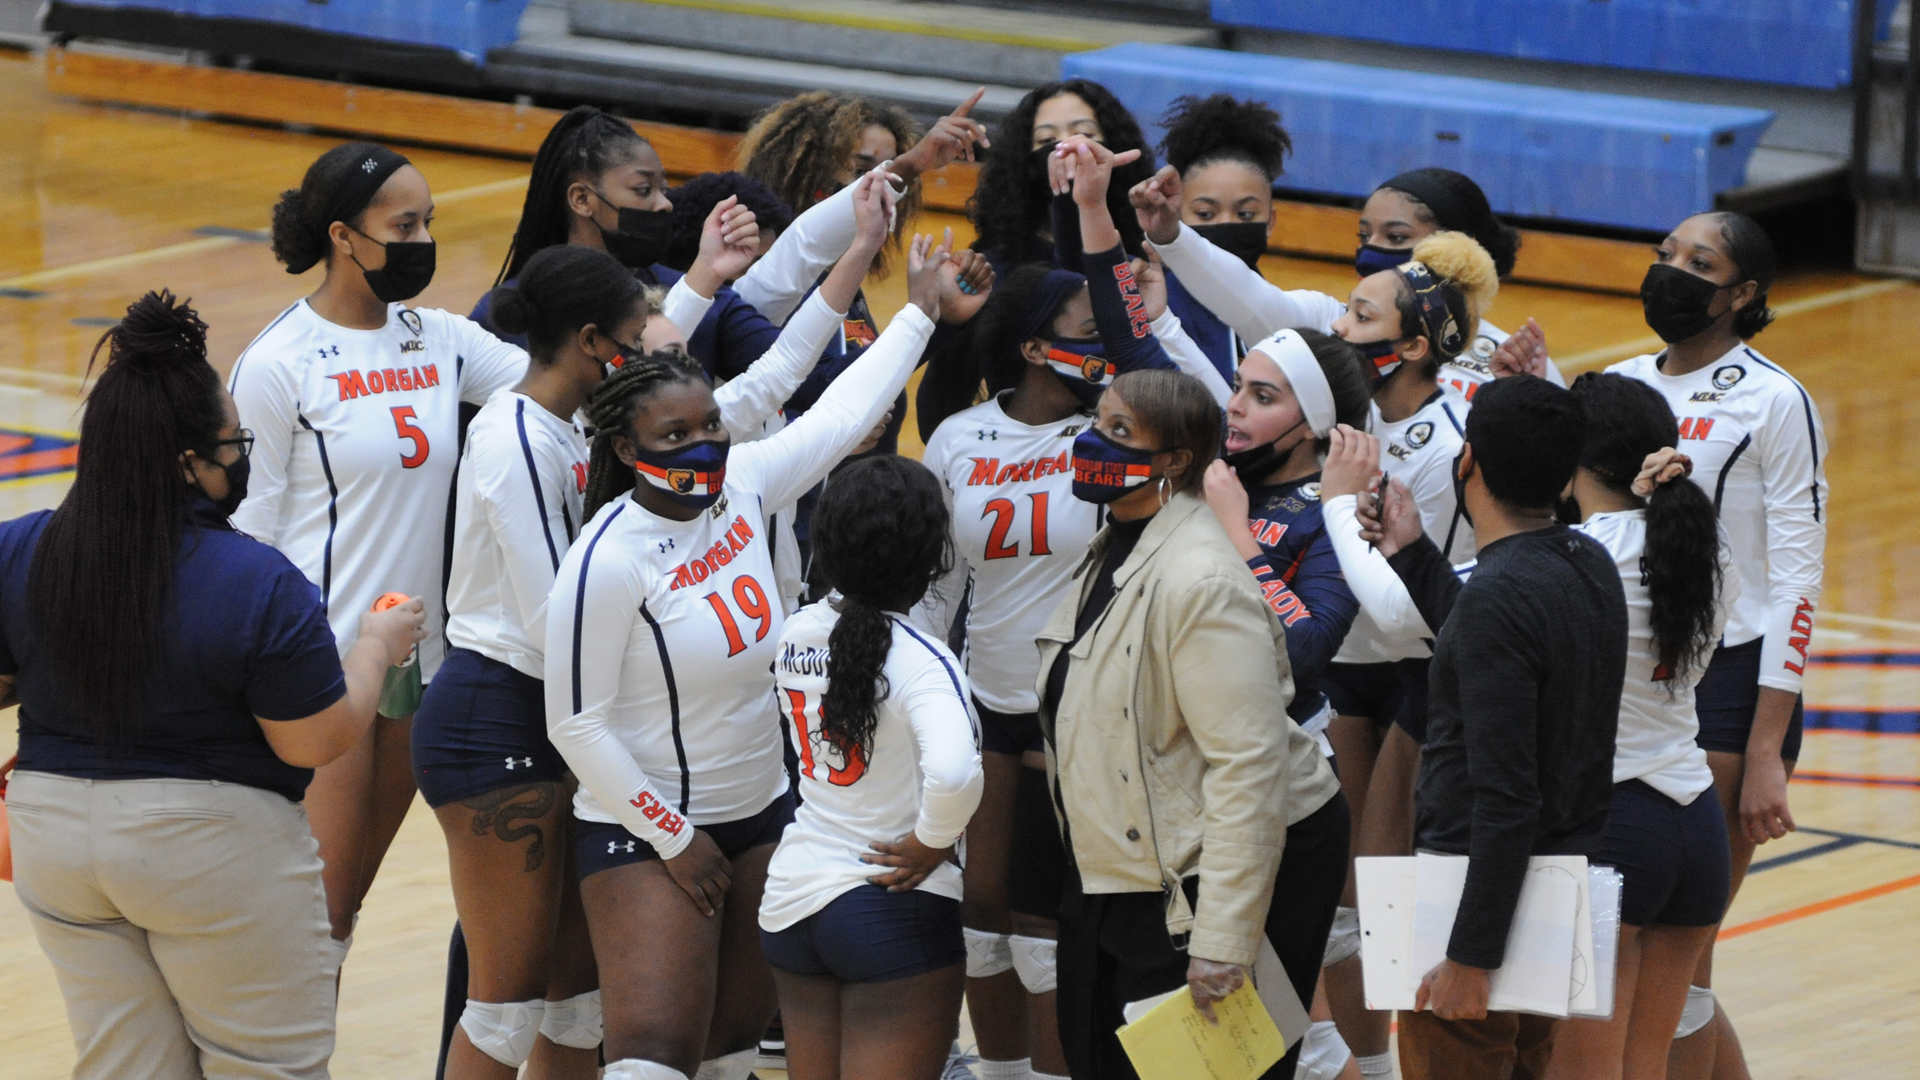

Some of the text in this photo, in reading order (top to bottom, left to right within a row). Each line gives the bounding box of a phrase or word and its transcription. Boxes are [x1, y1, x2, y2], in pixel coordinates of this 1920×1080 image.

[1112, 260, 1152, 338] BEARS
[324, 363, 440, 401] MORGAN
[389, 405, 430, 469] 5
[1676, 416, 1716, 441] AN
[967, 448, 1075, 486] MORGA
[1075, 469, 1125, 487] BEARS
[980, 491, 1053, 561] 21
[1249, 518, 1289, 547] AN
[664, 515, 755, 591] MORGAN
[701, 574, 772, 658] 19
[1783, 596, 1814, 677] LADY
[780, 641, 831, 678] McDU
[629, 790, 686, 837] EARS
